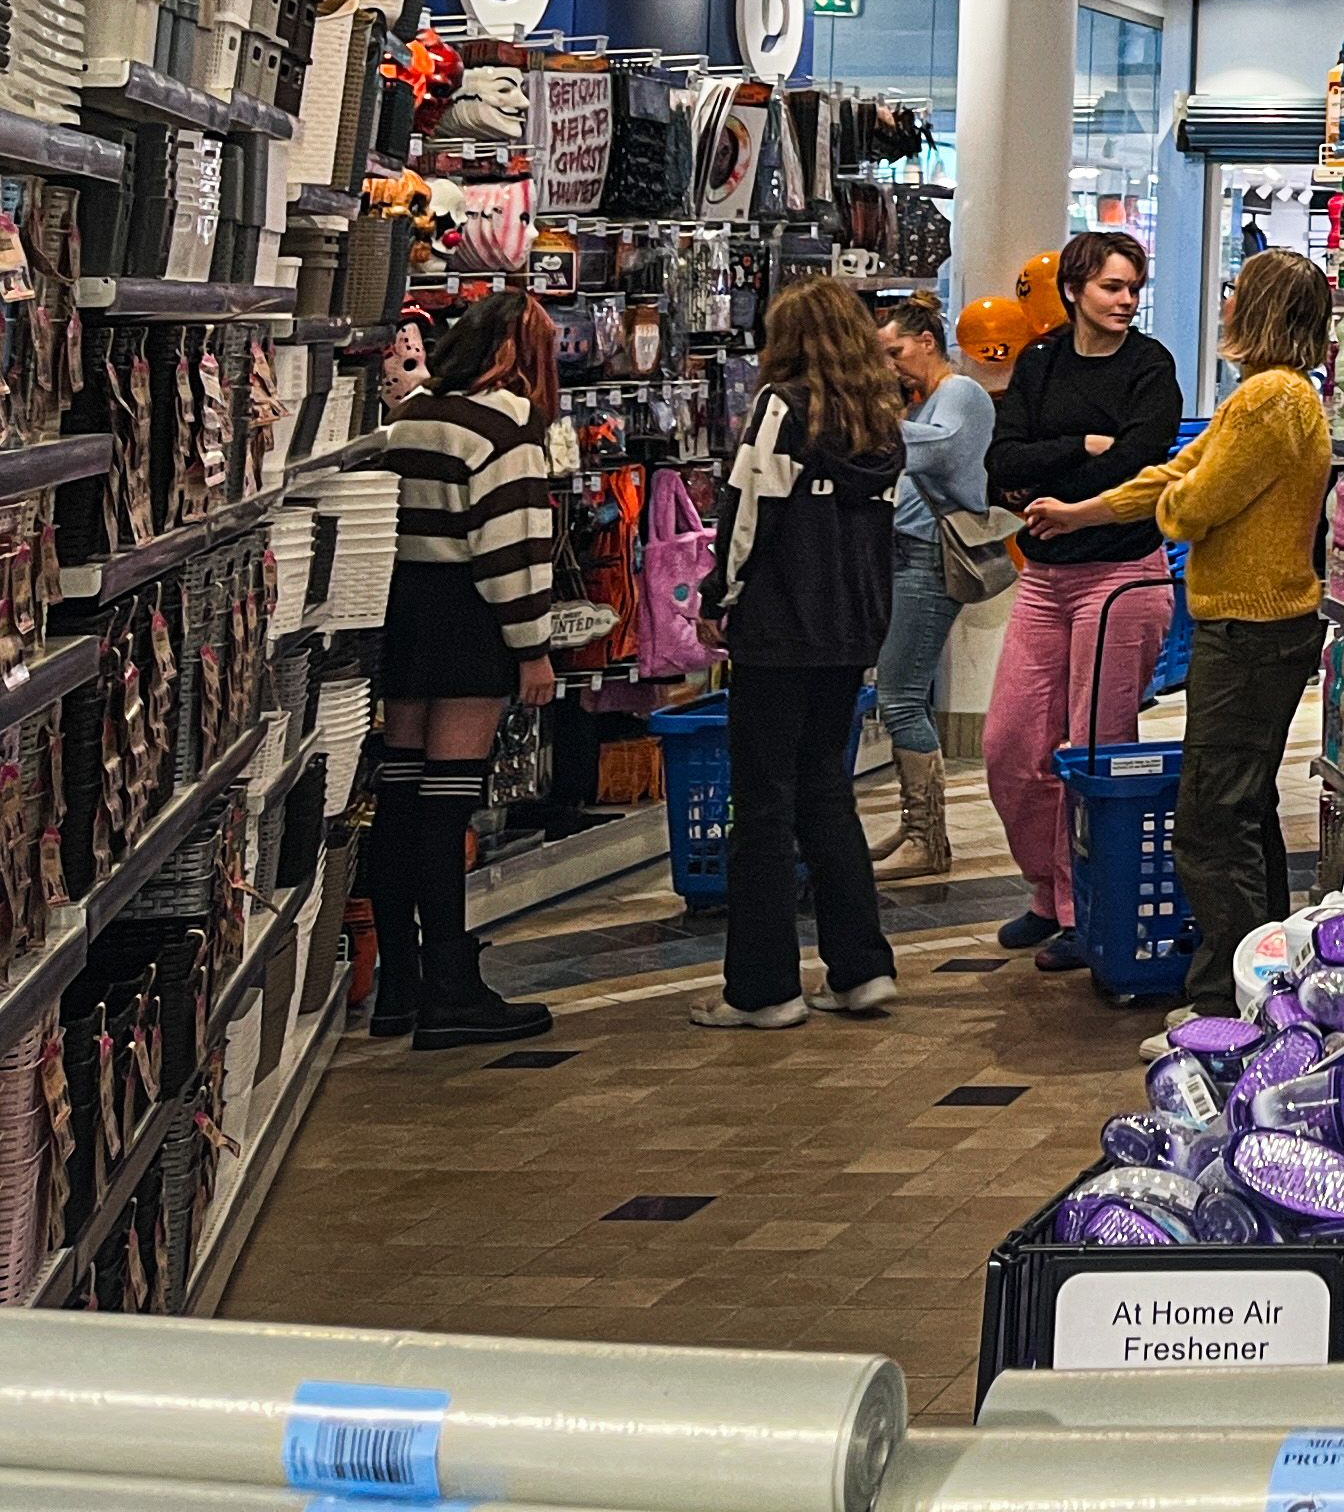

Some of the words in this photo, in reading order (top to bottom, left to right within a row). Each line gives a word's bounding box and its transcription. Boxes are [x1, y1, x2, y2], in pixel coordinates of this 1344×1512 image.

[549, 80, 577, 111] GET
[551, 108, 608, 144] HELP
[555, 141, 608, 174] GHOST
[551, 617, 594, 634] UNTED
[1112, 1300, 1142, 1326] At
[1151, 1299, 1234, 1326] Home
[1244, 1299, 1283, 1325] Air
[1124, 1335, 1269, 1362] Freshener
